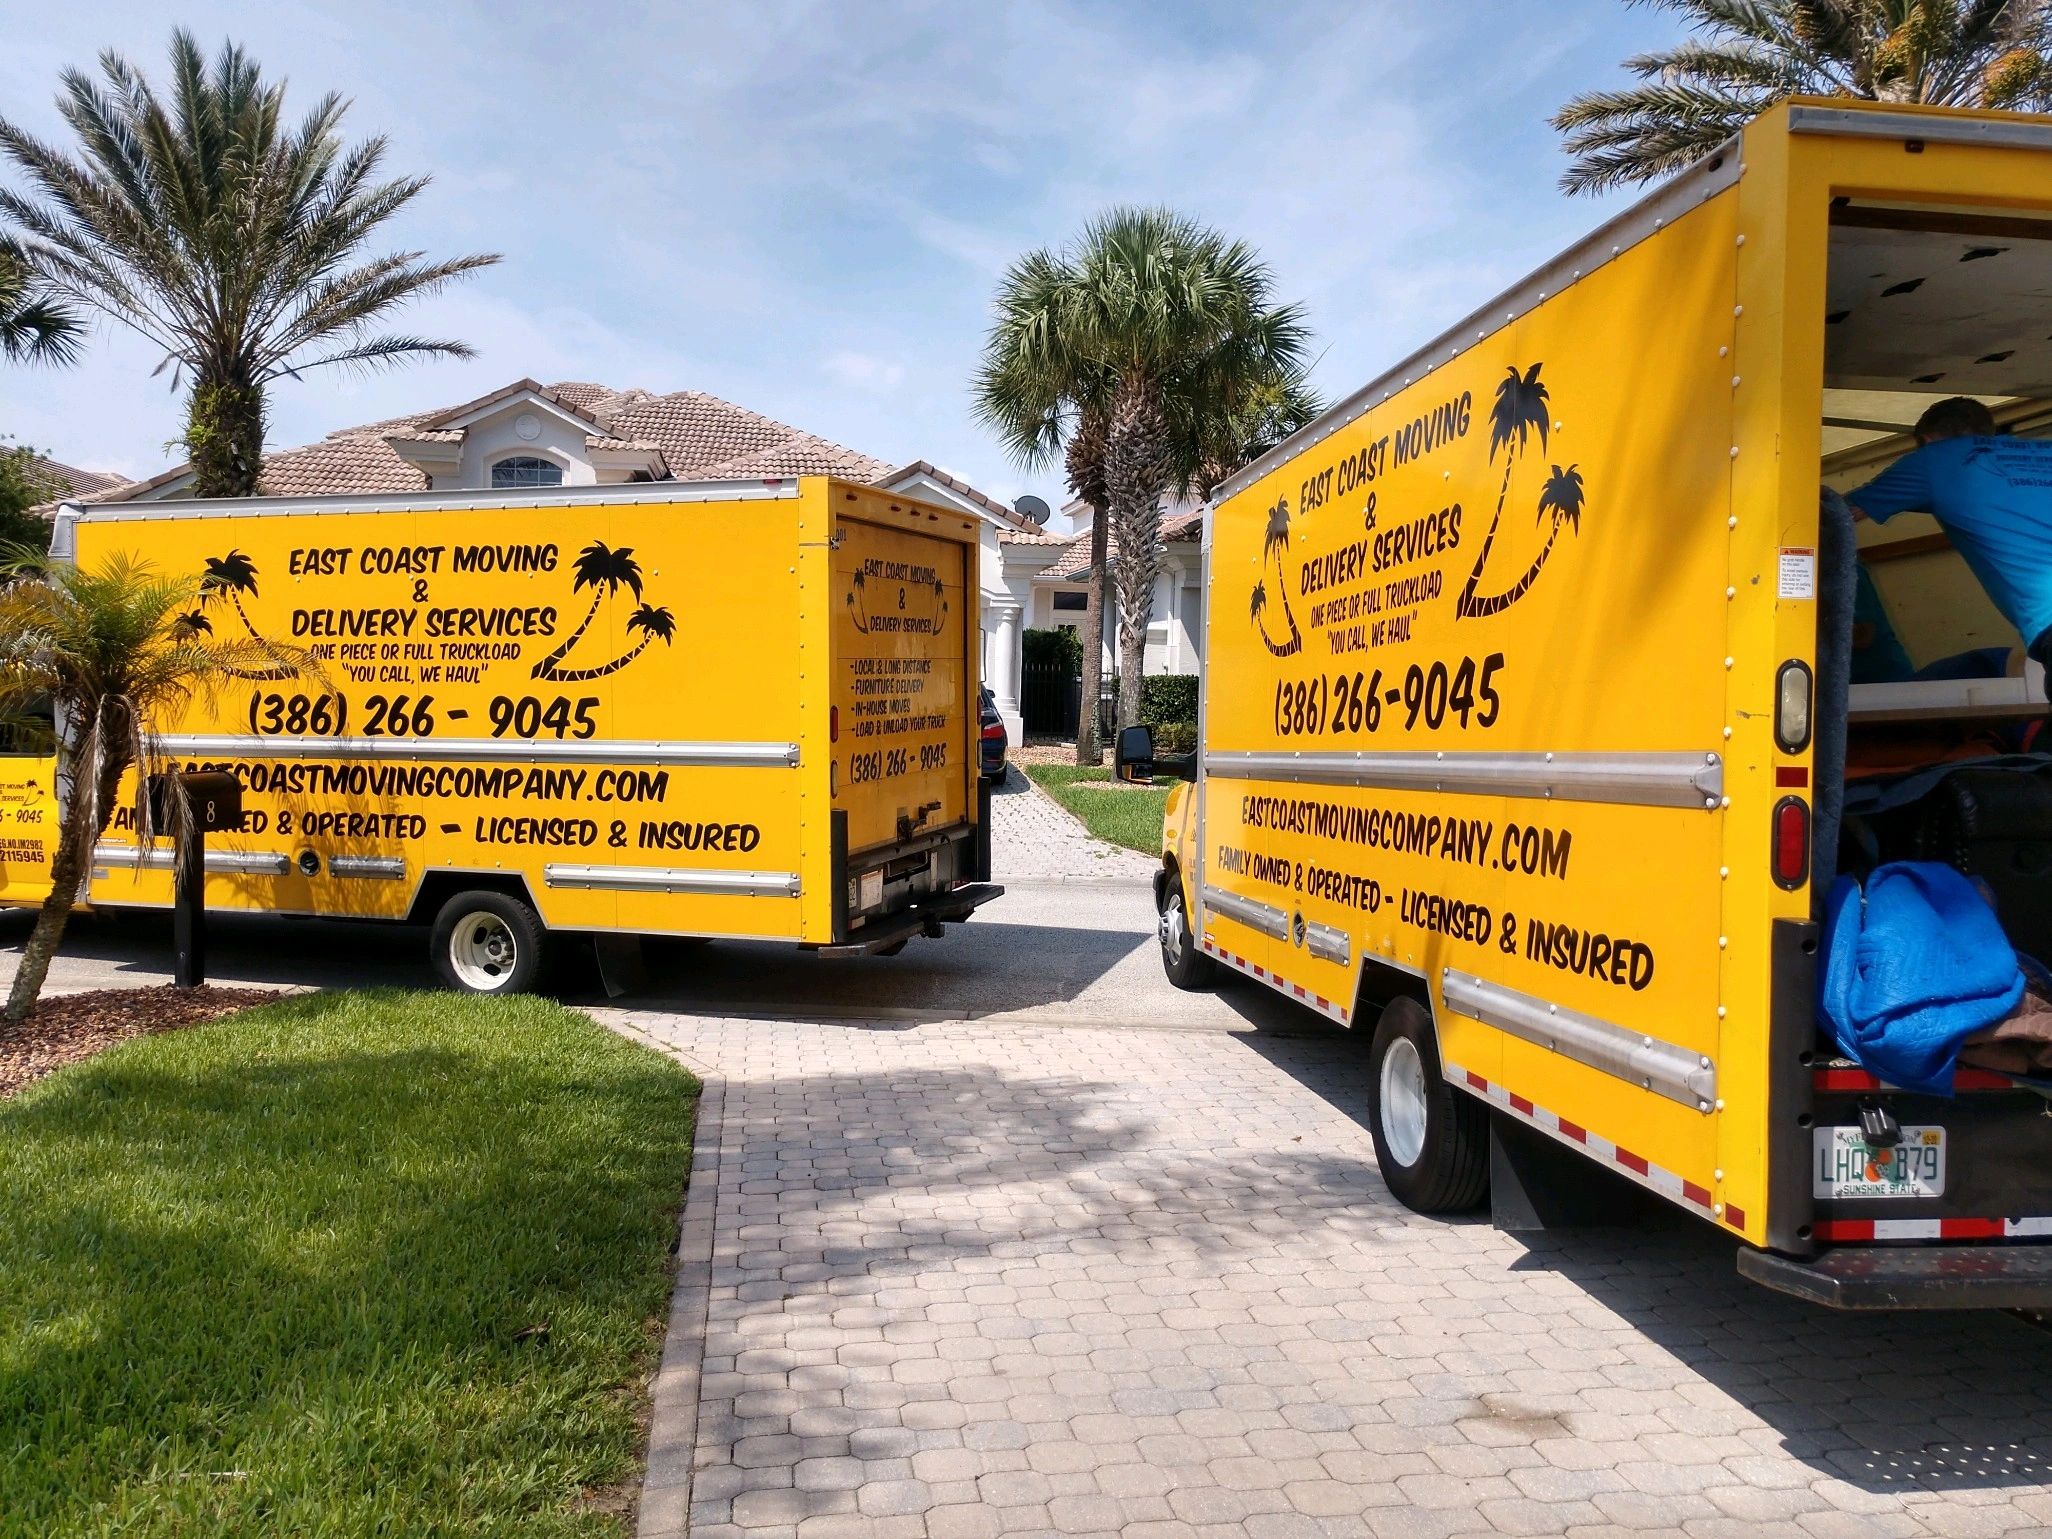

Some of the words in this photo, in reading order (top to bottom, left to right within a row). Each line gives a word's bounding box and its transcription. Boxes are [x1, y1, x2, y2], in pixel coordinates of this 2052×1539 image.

[1300, 466, 1333, 516] EAST
[1337, 437, 1389, 497] COAST
[1394, 390, 1472, 469] MOVING
[1365, 491, 1376, 531] &
[289, 548, 354, 576] EAST
[360, 545, 444, 574] COAST
[453, 543, 559, 573] MOVING
[1301, 539, 1368, 597] DELIVERY
[1372, 503, 1462, 573] SERVICES
[864, 559, 883, 578] EAST
[885, 561, 909, 581] COAST
[910, 565, 936, 586] MOVING
[412, 579, 429, 603] &
[898, 587, 905, 610] &
[1311, 604, 1325, 629] ONE
[1327, 596, 1347, 624] PIECE
[1349, 595, 1360, 619] OR
[1362, 587, 1382, 615] FULL
[1385, 570, 1442, 609] TRUCKLOAD
[292, 608, 418, 638] DELIVERY
[425, 607, 558, 637] SERVICES
[870, 616, 902, 632] DELIVERY
[903, 617, 932, 634] SERVICES
[311, 643, 335, 660] ONE
[341, 644, 377, 660] PIECE
[381, 644, 399, 661] OR
[404, 643, 435, 660] FULL
[439, 643, 521, 661] TRUCKLOAD
[1348, 623, 1368, 653] CALL,
[1371, 623, 1385, 648] WE
[379, 666, 415, 685] CALL,
[420, 666, 442, 683] WE
[877, 659, 882, 675] &
[884, 659, 901, 675] LONG
[902, 659, 932, 675] DISTANCE
[896, 678, 924, 694] DELIVERY
[1274, 673, 1328, 737] (386)
[1331, 652, 1505, 735] 266-9045
[249, 690, 348, 737] (386)
[363, 695, 435, 737] 266
[447, 708, 469, 720] -
[489, 695, 601, 740] 9045
[889, 698, 910, 714] MOVES
[876, 719, 881, 735] &
[883, 718, 908, 734] UNLOAD
[910, 715, 926, 732] YOUR
[927, 713, 946, 729] TRUCK
[850, 749, 882, 784] (386)
[886, 748, 907, 777] 266
[920, 742, 947, 771] 9045
[16, 809, 43, 823] 9045
[206, 800, 216, 823] 8
[276, 810, 292, 835] &
[302, 812, 426, 840] OPERATED
[440, 823, 461, 834] -
[475, 816, 598, 847] LICENSED
[607, 820, 628, 848] &
[638, 821, 761, 852] INSURED
[1242, 795, 1572, 881] EASTCOASTMOVINGCOMPANY.COM
[1218, 844, 1252, 877] FAMILY
[1253, 852, 1291, 888] OWNED
[1294, 862, 1303, 892] &
[1307, 866, 1381, 914] OPERATED
[1384, 895, 1394, 904] -
[1401, 887, 1493, 946] LICENSED
[1499, 912, 1517, 955] &
[1526, 918, 1655, 992] INSURED
[1821, 1146, 1864, 1182] LHQ
[1843, 1184, 1886, 1195] SUNSHINE
[1889, 1183, 1917, 1194] STATE
